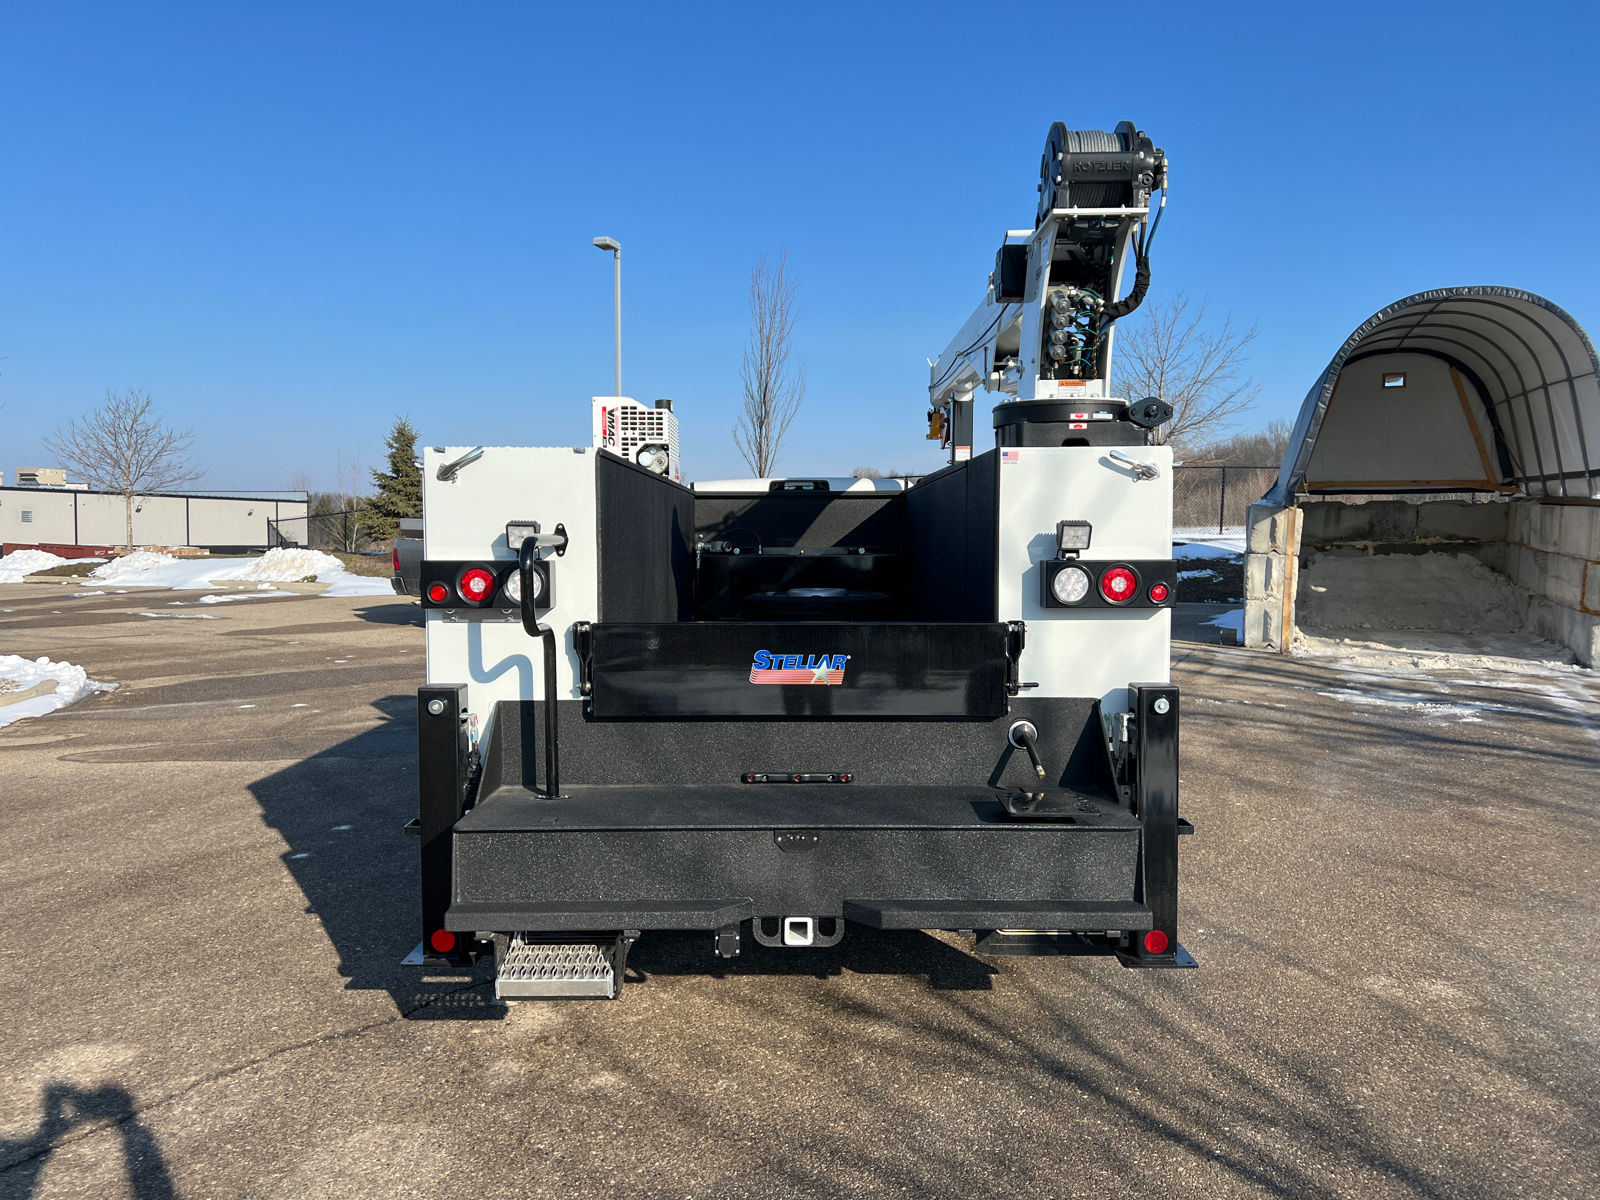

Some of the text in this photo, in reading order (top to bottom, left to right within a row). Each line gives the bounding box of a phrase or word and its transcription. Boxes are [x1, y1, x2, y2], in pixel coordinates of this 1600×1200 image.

[1073, 161, 1129, 171] ROTZLER
[607, 407, 616, 447] VMAC
[753, 649, 847, 670] STELLAR
